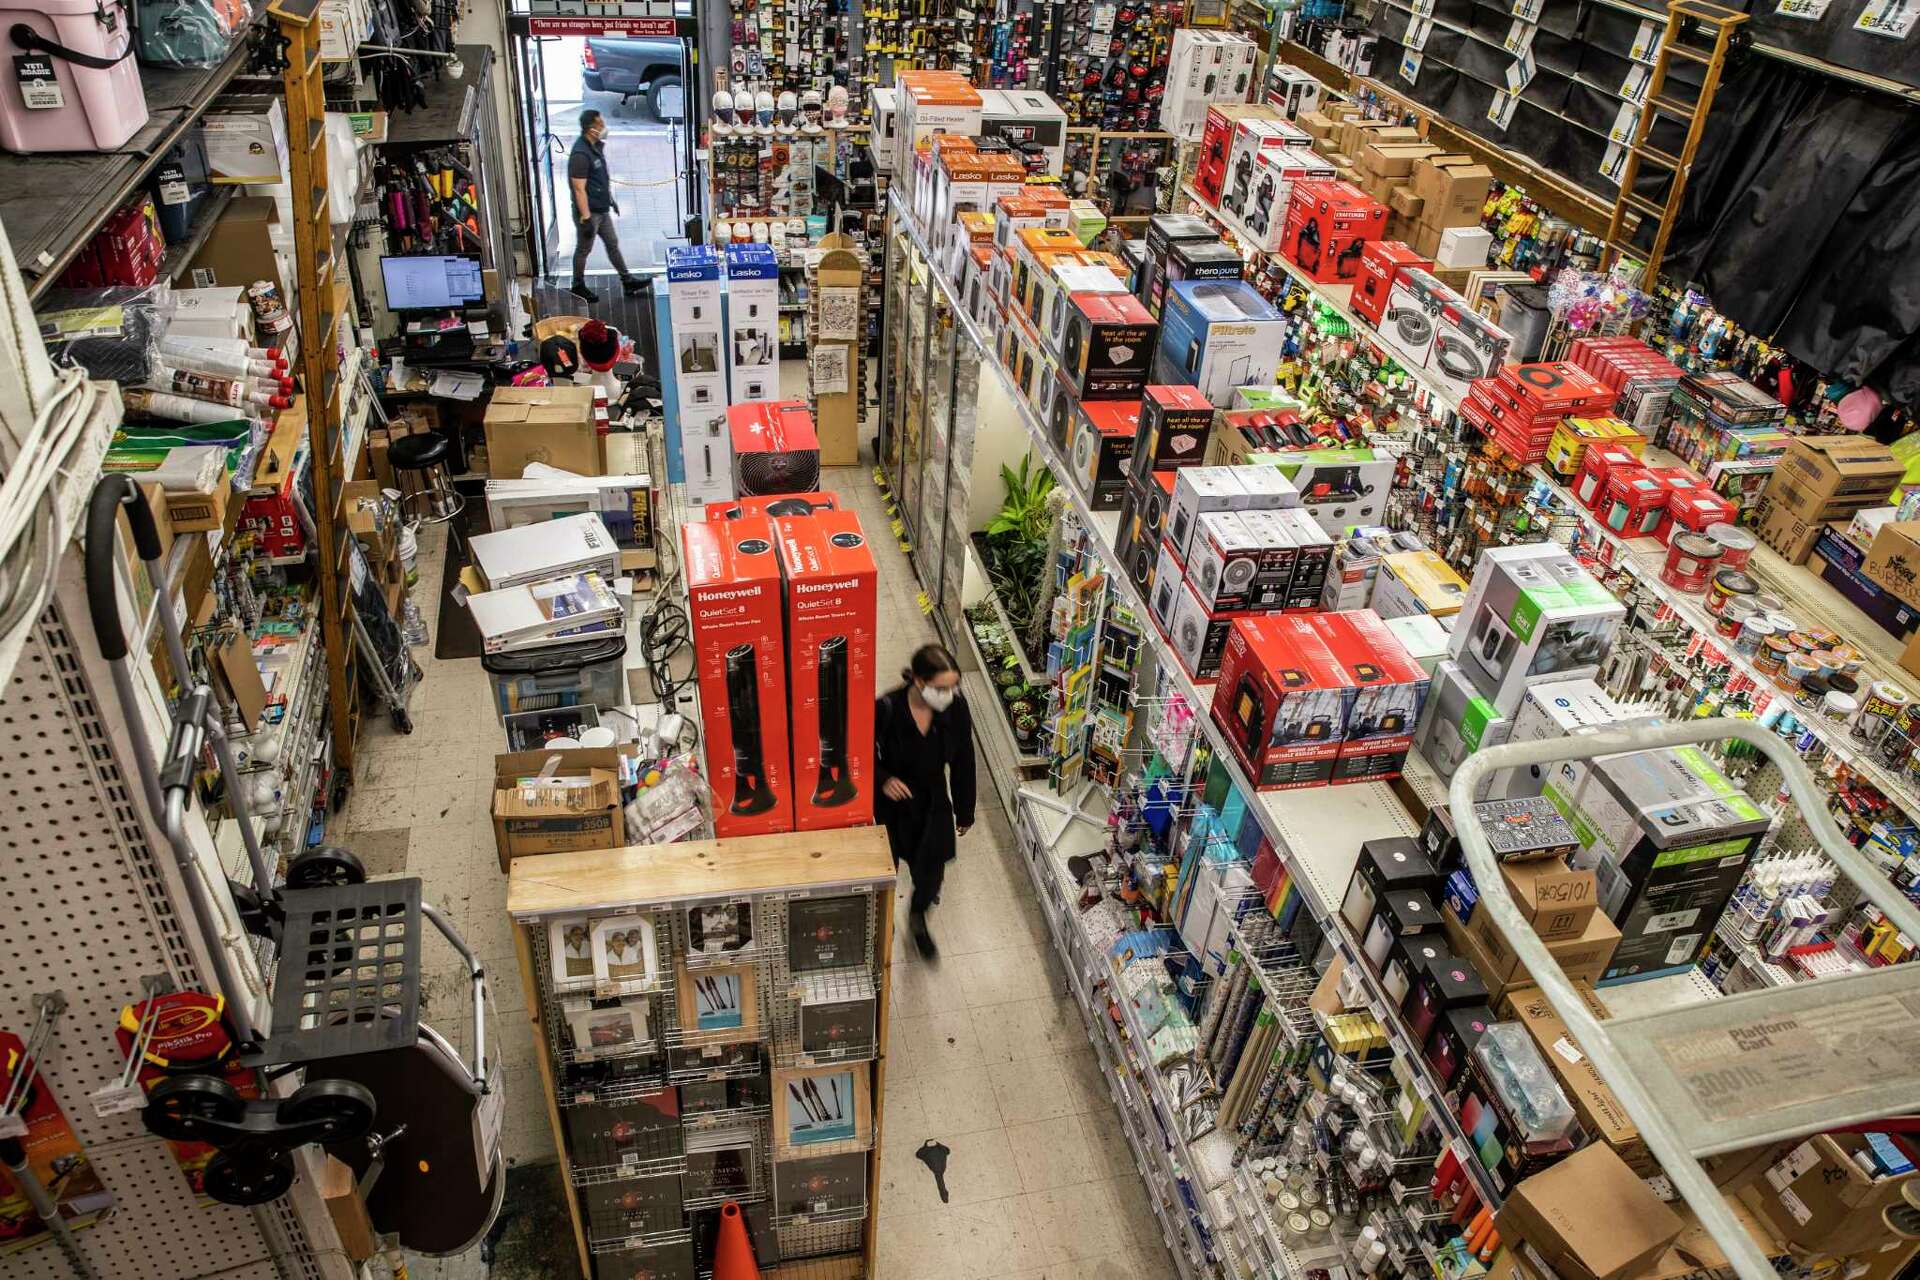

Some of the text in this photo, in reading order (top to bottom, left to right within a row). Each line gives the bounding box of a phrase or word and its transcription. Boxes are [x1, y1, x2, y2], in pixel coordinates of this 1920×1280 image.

[953, 172, 982, 180] Lasko
[990, 172, 1020, 181] Lasko
[671, 270, 703, 279] Lasko
[730, 268, 762, 277] Lasko
[1210, 325, 1257, 336] Filtrete
[632, 490, 649, 546] Filtrete
[796, 578, 859, 593] Honeywell
[698, 586, 762, 602] Honeywell
[798, 600, 833, 609] QuietSet
[700, 606, 737, 618] QuietSet
[195, 1032, 213, 1040] Pro
[1728, 1019, 1798, 1042] Platform
[1738, 1036, 1774, 1052] Cart
